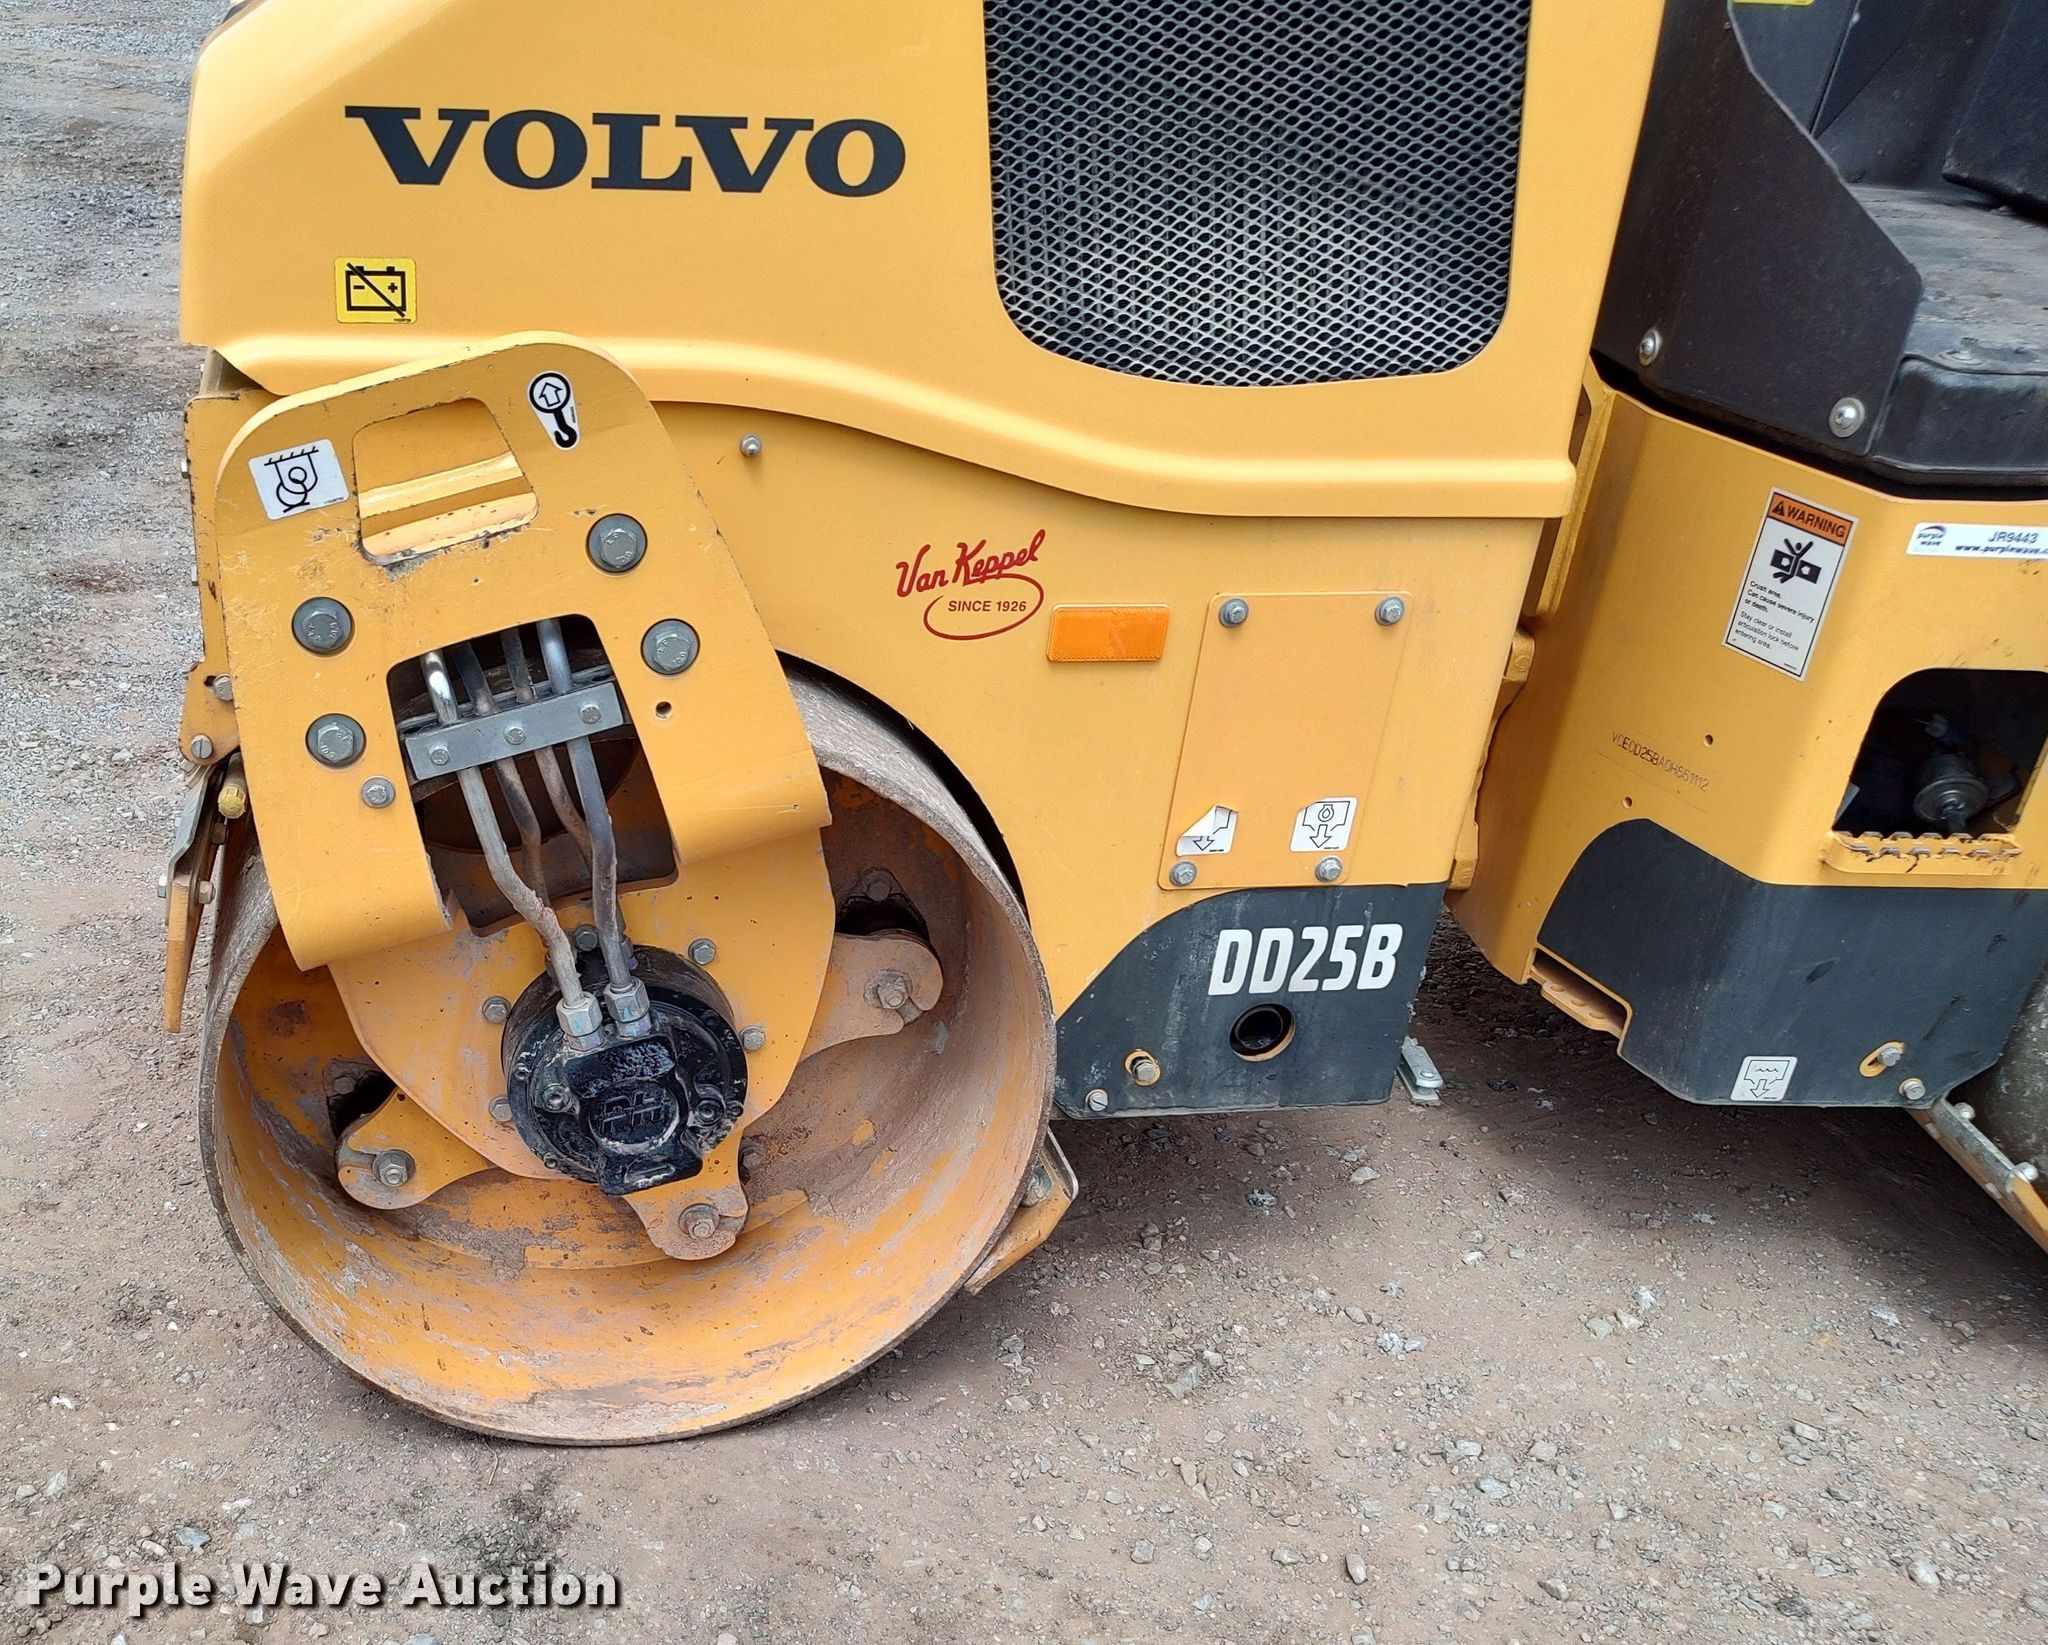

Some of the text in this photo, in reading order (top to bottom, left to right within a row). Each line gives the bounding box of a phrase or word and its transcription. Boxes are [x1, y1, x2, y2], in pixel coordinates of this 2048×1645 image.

[345, 105, 906, 198] VOLVO
[1787, 505, 1846, 538] WARNING
[1988, 531, 2039, 544] JR9443
[896, 528, 1046, 598] Van Keppel
[948, 600, 1027, 612] SINCE 1926
[1208, 923, 1404, 996] DD25B
